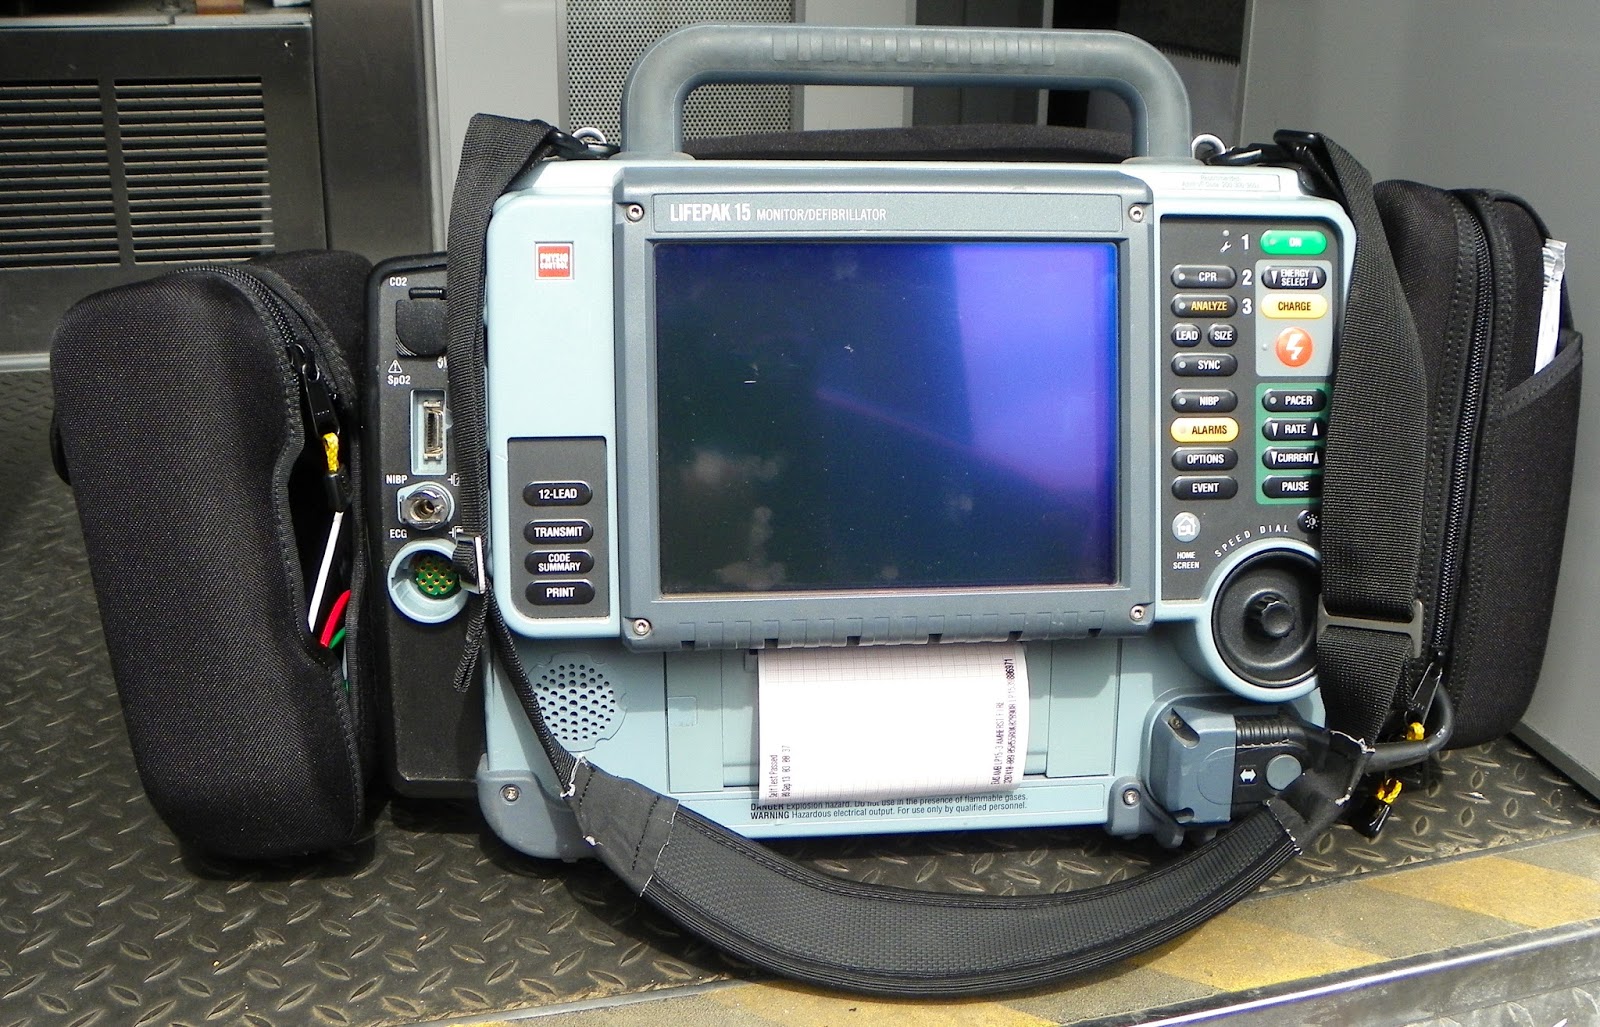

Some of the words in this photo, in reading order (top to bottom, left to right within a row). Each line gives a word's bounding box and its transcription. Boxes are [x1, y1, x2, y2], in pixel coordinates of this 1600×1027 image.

[670, 203, 731, 222] LIFEPAK
[735, 203, 751, 222] 15
[756, 208, 887, 222] MONITOR/DEFIBRILLATOR
[1241, 234, 1250, 250] 1
[1288, 236, 1302, 247] ON
[1198, 272, 1217, 282] CPR
[1242, 269, 1252, 286] 2
[1280, 269, 1310, 278] ENERGY
[389, 276, 408, 287] CO2
[1281, 277, 1309, 287] SELECT
[1191, 301, 1228, 311] ANALYZE
[1242, 298, 1252, 315] 3
[1278, 302, 1311, 311] CHARGE
[1176, 331, 1198, 341] LEAD
[1214, 331, 1233, 341] SIZE
[1197, 360, 1221, 370] SYNC
[387, 375, 411, 387] SpO2
[1199, 396, 1220, 406] NIBP
[1285, 396, 1313, 406] PACER
[1191, 425, 1228, 435] ALARMS
[1285, 424, 1307, 434] RATE
[1186, 454, 1225, 464] OPTIONS
[1278, 453, 1313, 463] CURRENT
[386, 474, 408, 485] NIBP
[1192, 483, 1220, 493] EVENT
[1281, 481, 1310, 492] PAUSE
[538, 489, 578, 499] 12-LEAD
[389, 529, 408, 539] ECG
[534, 527, 584, 537] TRANSMIT
[1214, 530, 1251, 558] SPEED
[1260, 524, 1289, 534] DIAL
[548, 554, 571, 562] CODE
[1176, 551, 1196, 560] HOME
[538, 562, 581, 572] SUMMARY
[1173, 561, 1200, 570] SCREEN
[546, 587, 576, 598] PRINT
[906, 797, 918, 806] the
[920, 797, 953, 807] presence
[955, 796, 963, 804] of
[964, 793, 1003, 804] flammable
[1005, 793, 1029, 803] gases.
[750, 810, 790, 820] WARNING
[792, 809, 832, 819] Hazardous
[833, 807, 867, 817] electrical
[869, 806, 895, 817] output.
[897, 807, 909, 815] For
[911, 806, 925, 814] use
[927, 804, 943, 814] only
[944, 804, 954, 814] by
[955, 802, 987, 813] qualified
[988, 801, 1028, 812] personnel.
